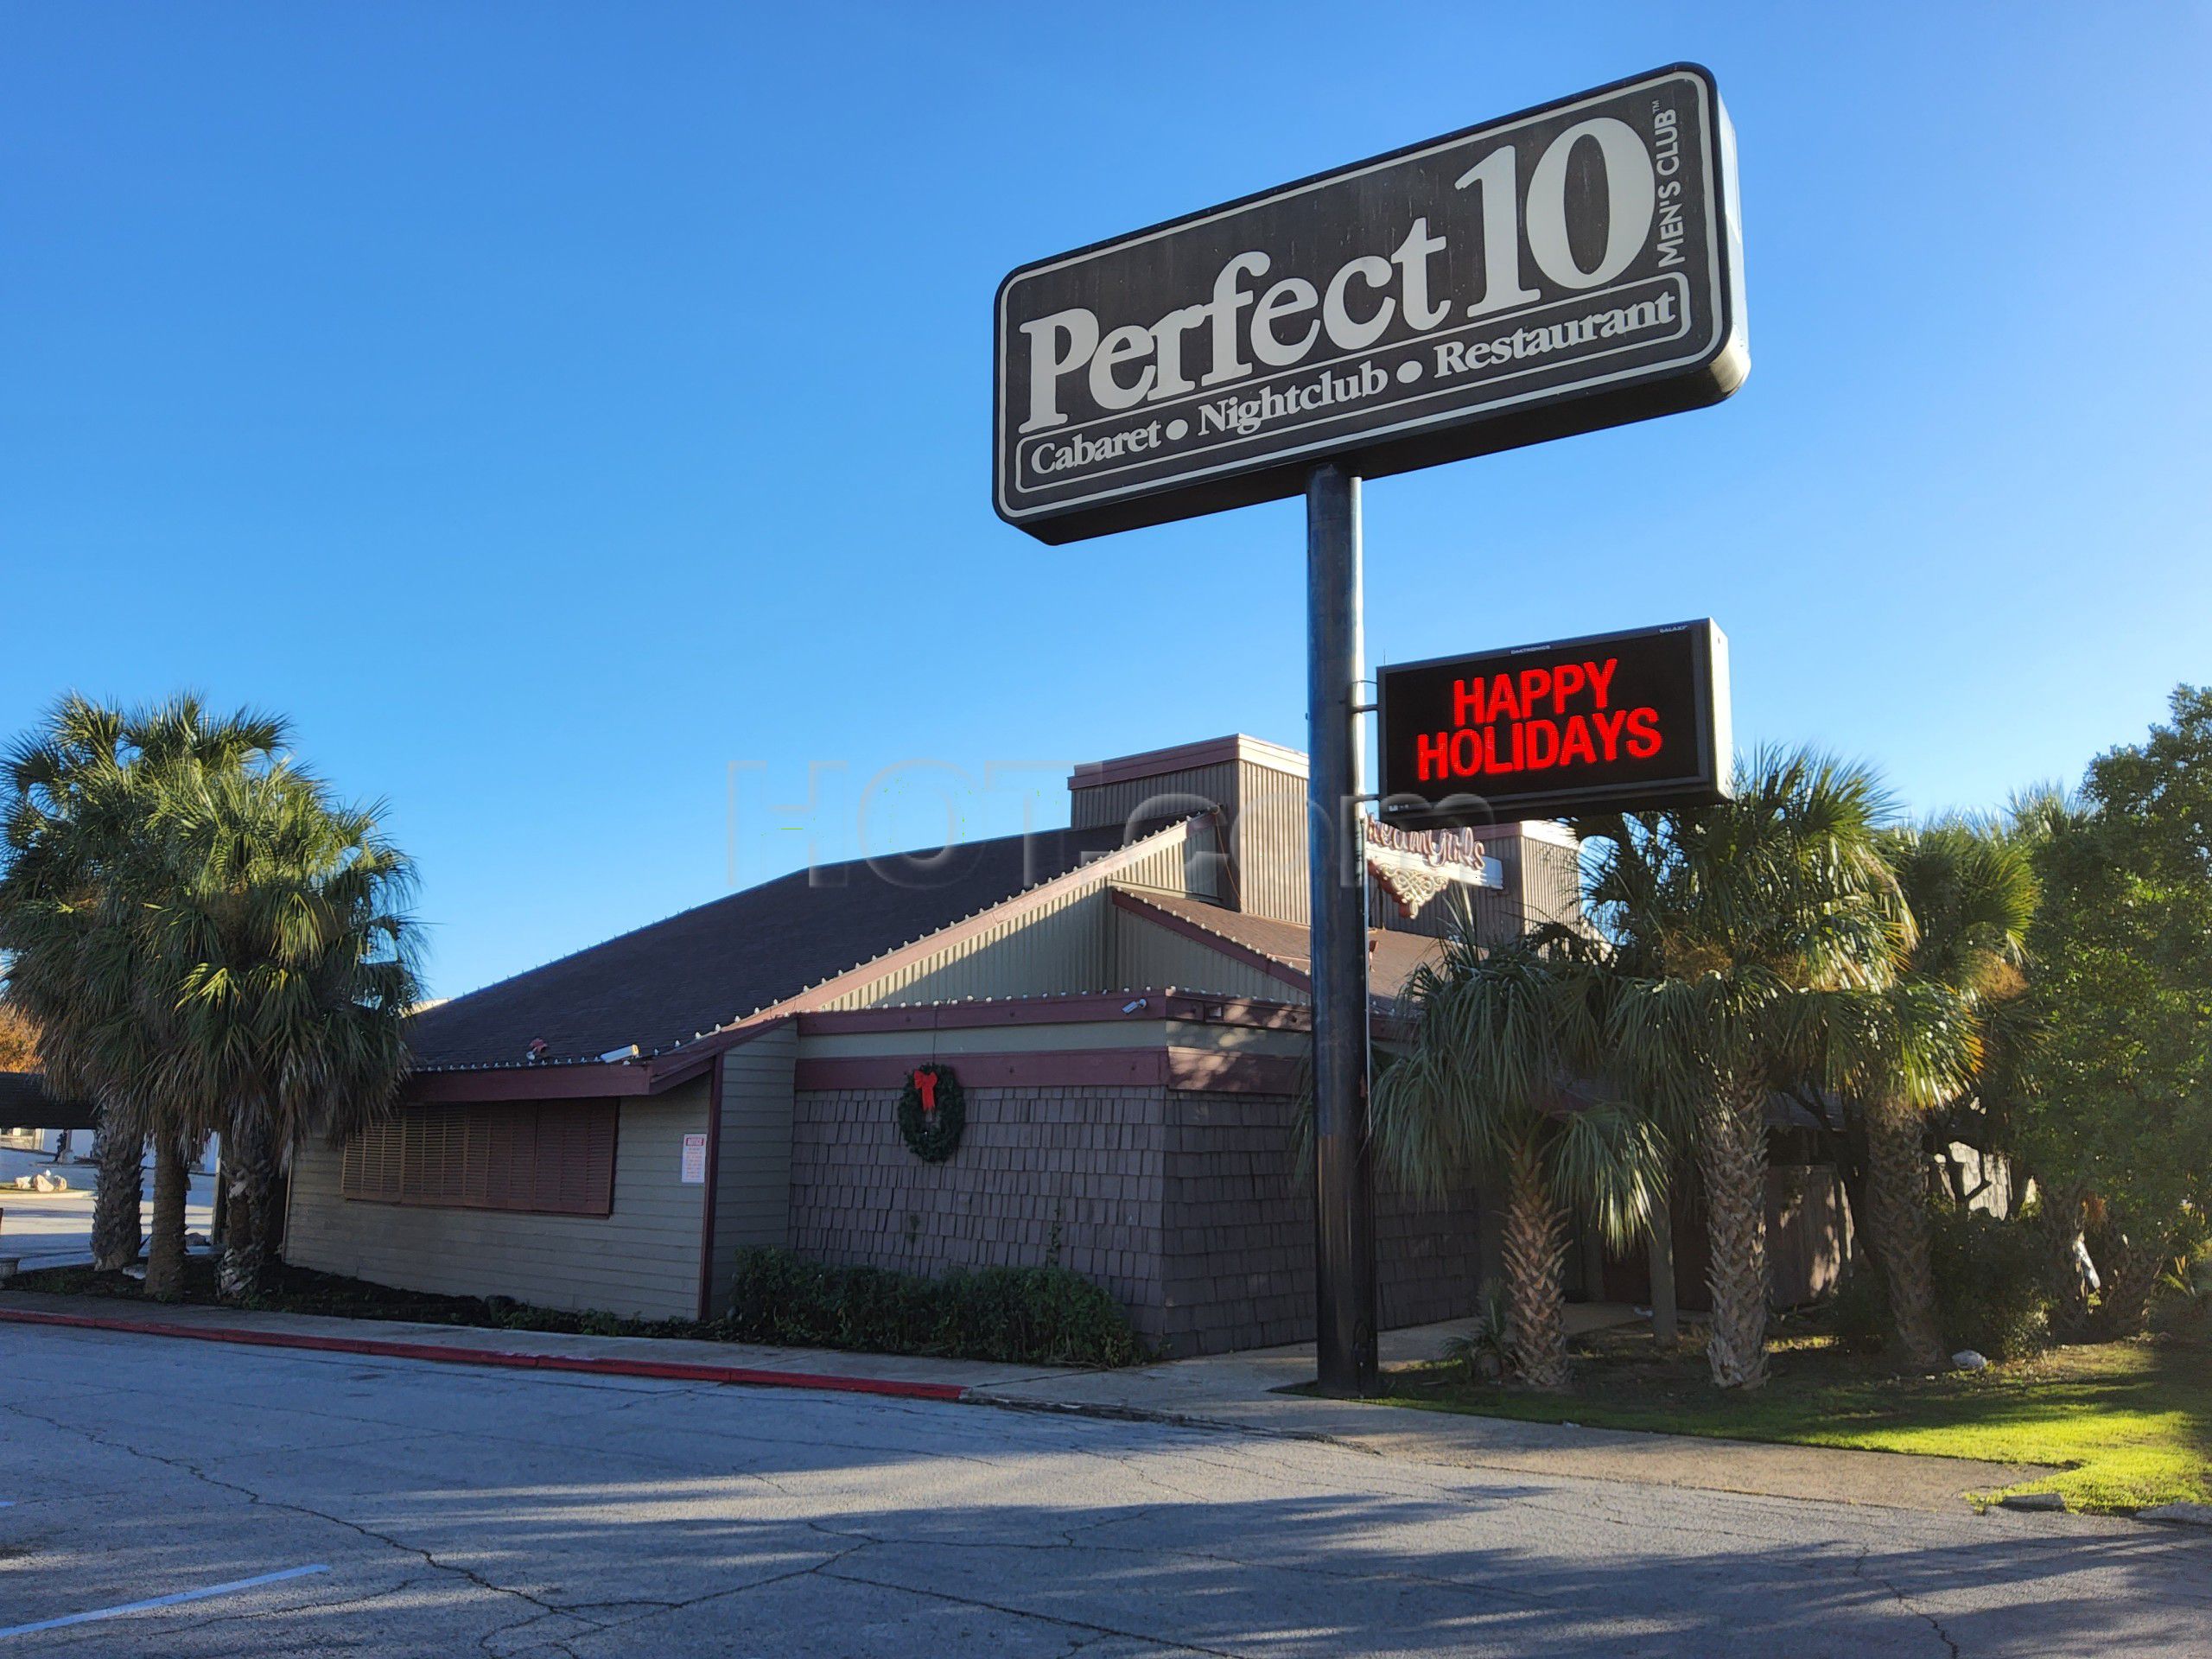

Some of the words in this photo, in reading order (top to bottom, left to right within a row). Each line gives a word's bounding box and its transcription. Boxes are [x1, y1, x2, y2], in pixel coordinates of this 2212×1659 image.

[1654, 109, 1680, 176] CLUB
[1656, 181, 1686, 268] MEN'S
[1018, 216, 1452, 434] Perfect
[1455, 117, 1657, 318] 10
[1030, 422, 1162, 474] Cabaret
[1198, 360, 1389, 435] Nightclub
[1433, 291, 1676, 378] Restaurant
[1452, 658, 1618, 728] HAPPY
[1416, 707, 1664, 781] HOLIDAYS
